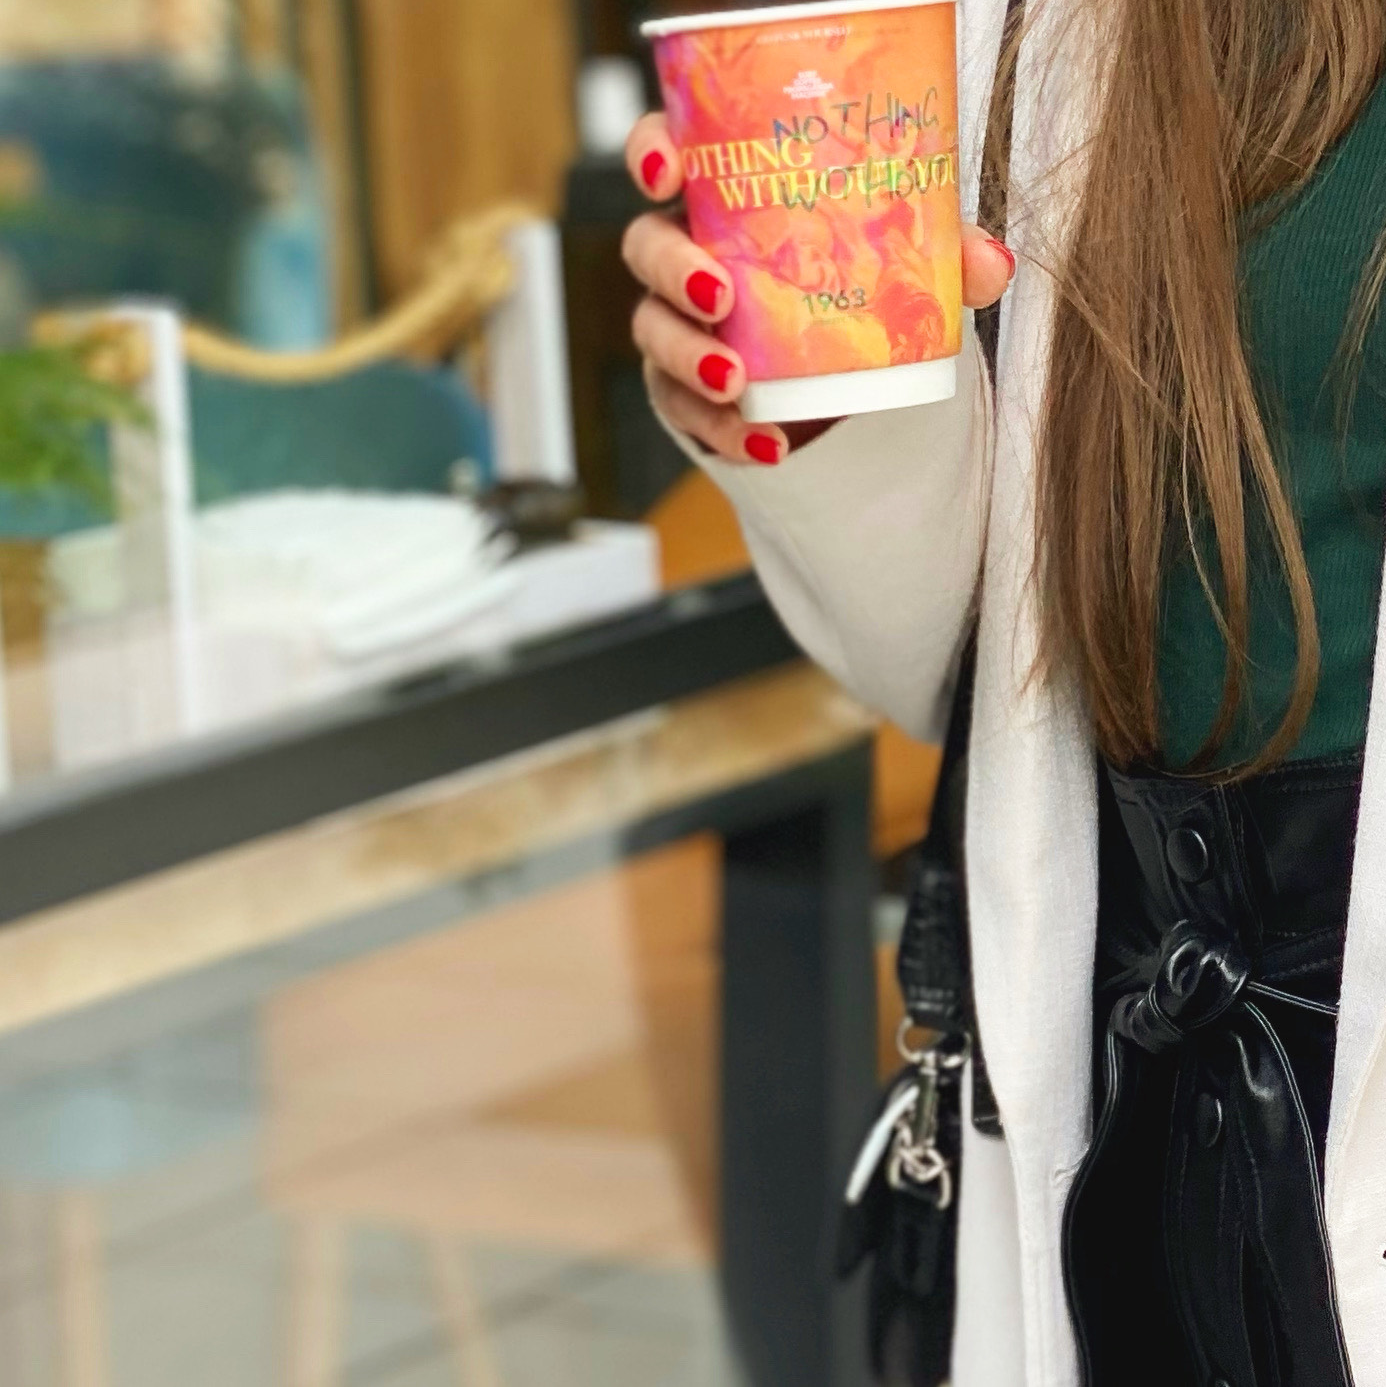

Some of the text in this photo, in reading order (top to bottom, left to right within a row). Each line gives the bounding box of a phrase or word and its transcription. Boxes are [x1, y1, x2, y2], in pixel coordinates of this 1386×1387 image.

[771, 86, 939, 156] NOTHING
[683, 135, 813, 181] OTHING
[802, 288, 866, 315] 1963
